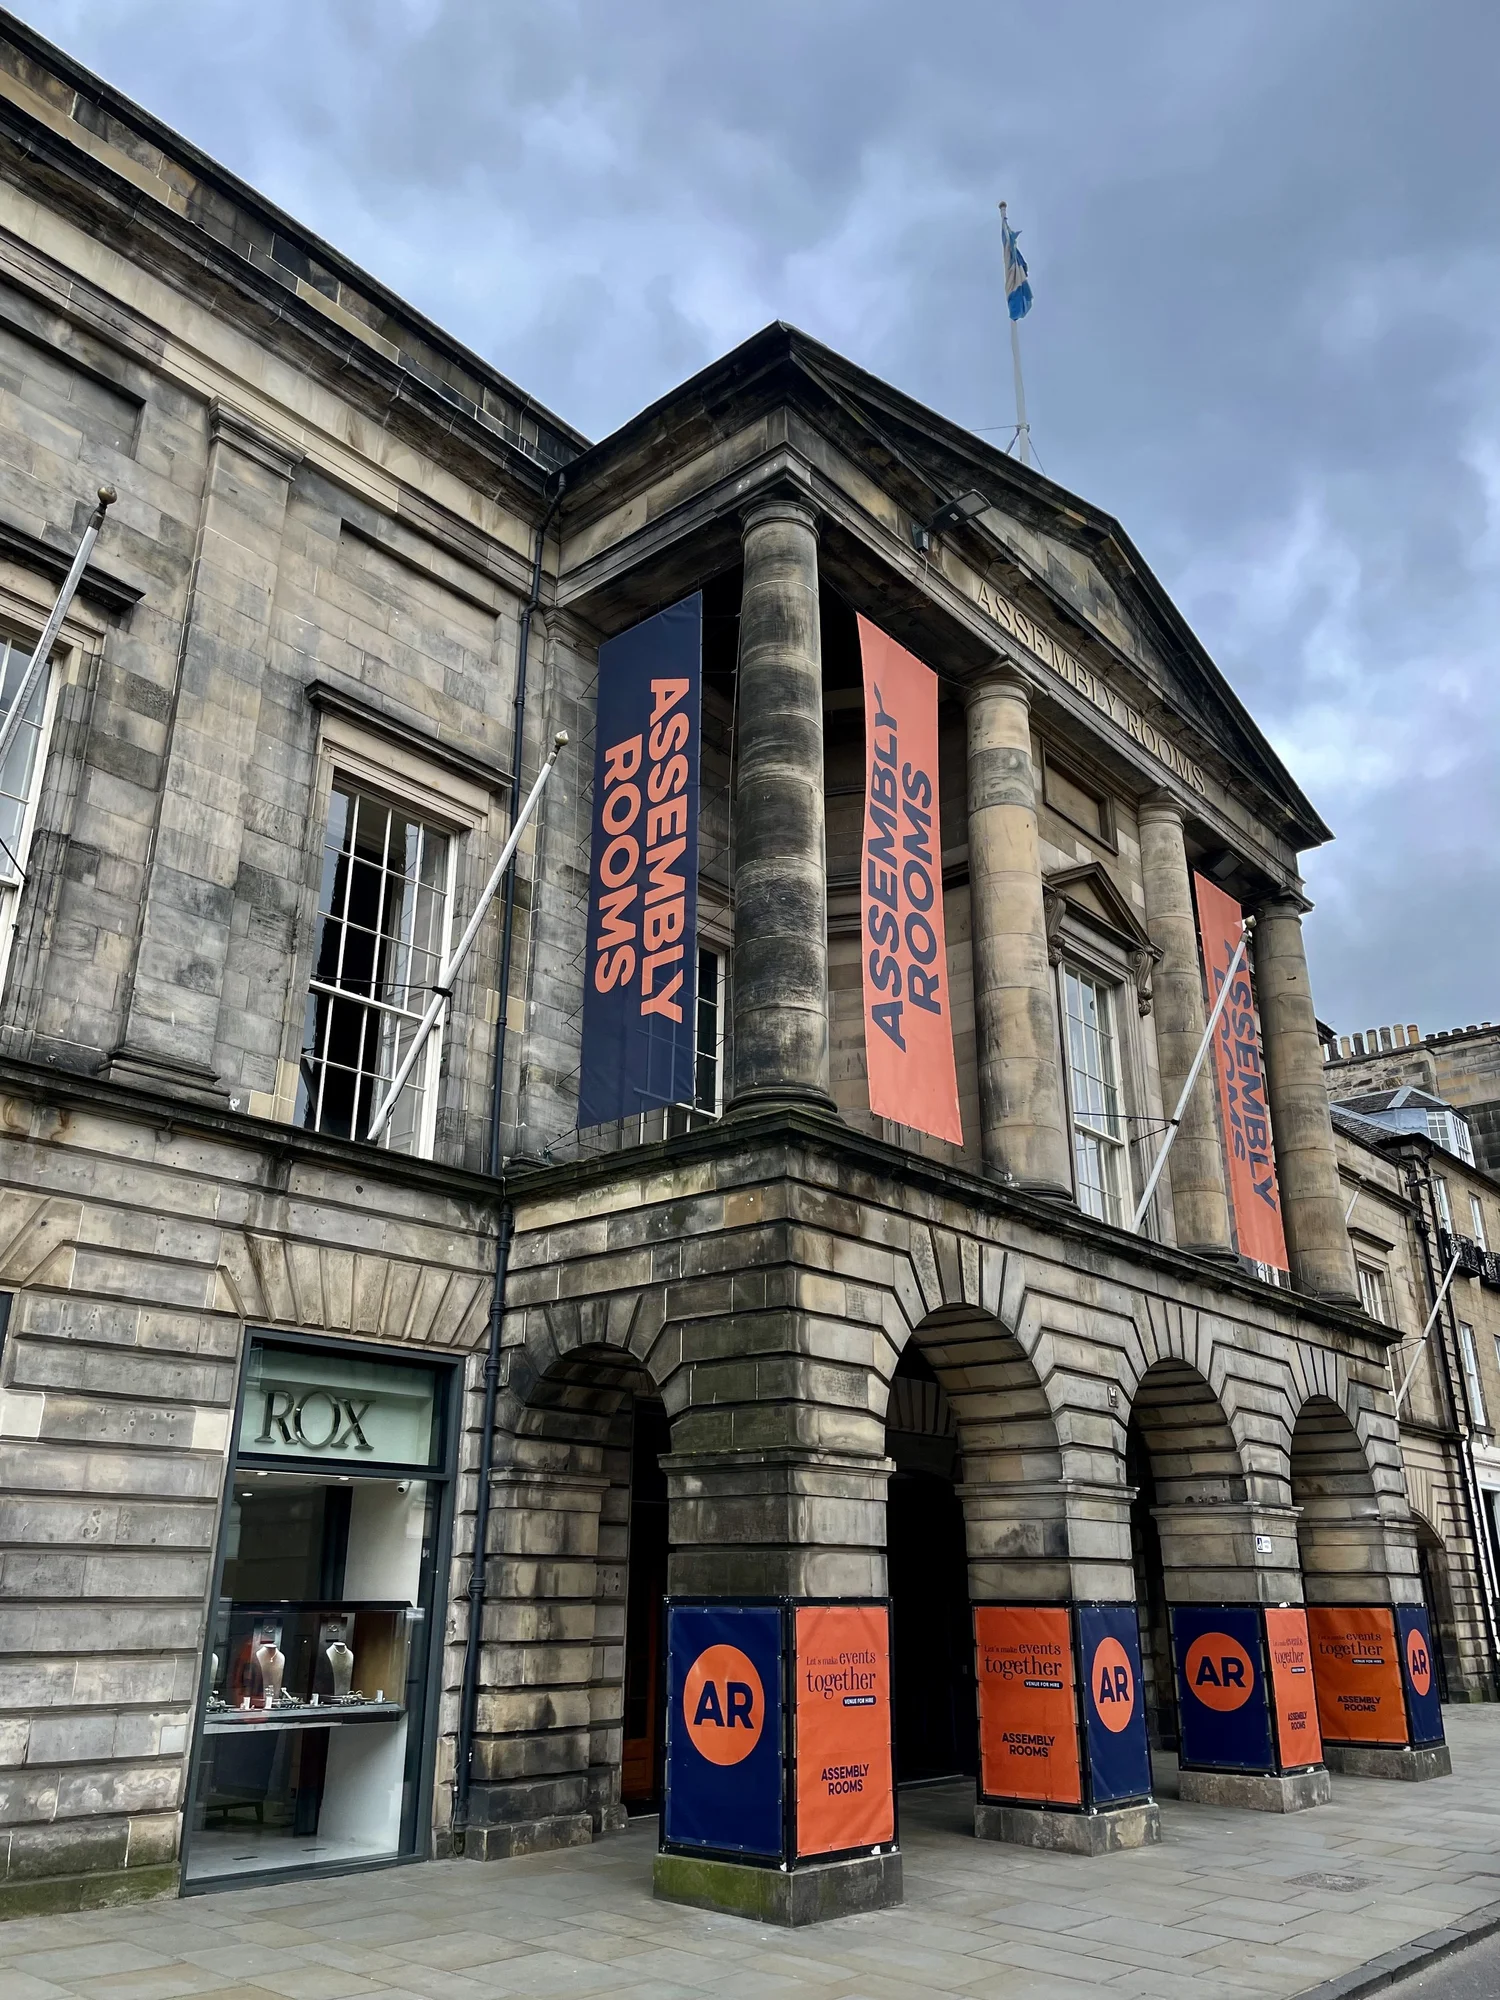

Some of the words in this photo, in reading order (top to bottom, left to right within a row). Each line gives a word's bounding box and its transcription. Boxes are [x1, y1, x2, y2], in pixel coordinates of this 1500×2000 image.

[977, 581, 1117, 719] ASSEMBLY
[1126, 704, 1206, 796] ROOMS
[640, 678, 690, 1024] ASSEMBLY
[595, 733, 643, 994] ROOMS
[868, 682, 907, 1053] ASSEMBLY
[903, 762, 942, 1015] ROOMS
[1224, 938, 1277, 1211] ASSEMBLY
[254, 1389, 376, 1450] ROX
[1346, 1632, 1382, 1641] events
[840, 1648, 876, 1665] events
[1019, 1642, 1061, 1655] events
[1274, 1647, 1304, 1669] together
[1319, 1641, 1383, 1659] together
[984, 1655, 1062, 1680] together
[1195, 1656, 1246, 1688] AR
[1412, 1649, 1428, 1675] AR
[806, 1666, 876, 1700] together
[1099, 1665, 1130, 1703] AR
[693, 1680, 754, 1729] AR
[1337, 1695, 1381, 1704] ASSEMBLY
[1344, 1703, 1376, 1712] ROOMS
[1287, 1711, 1307, 1721] ASSEMBLY
[1290, 1720, 1306, 1730] ROOMS
[1002, 1732, 1055, 1746] ASSEMBLY
[1009, 1744, 1048, 1757] ROOMS
[821, 1763, 869, 1781] ASSEMBLY
[828, 1779, 863, 1795] ROOMS
